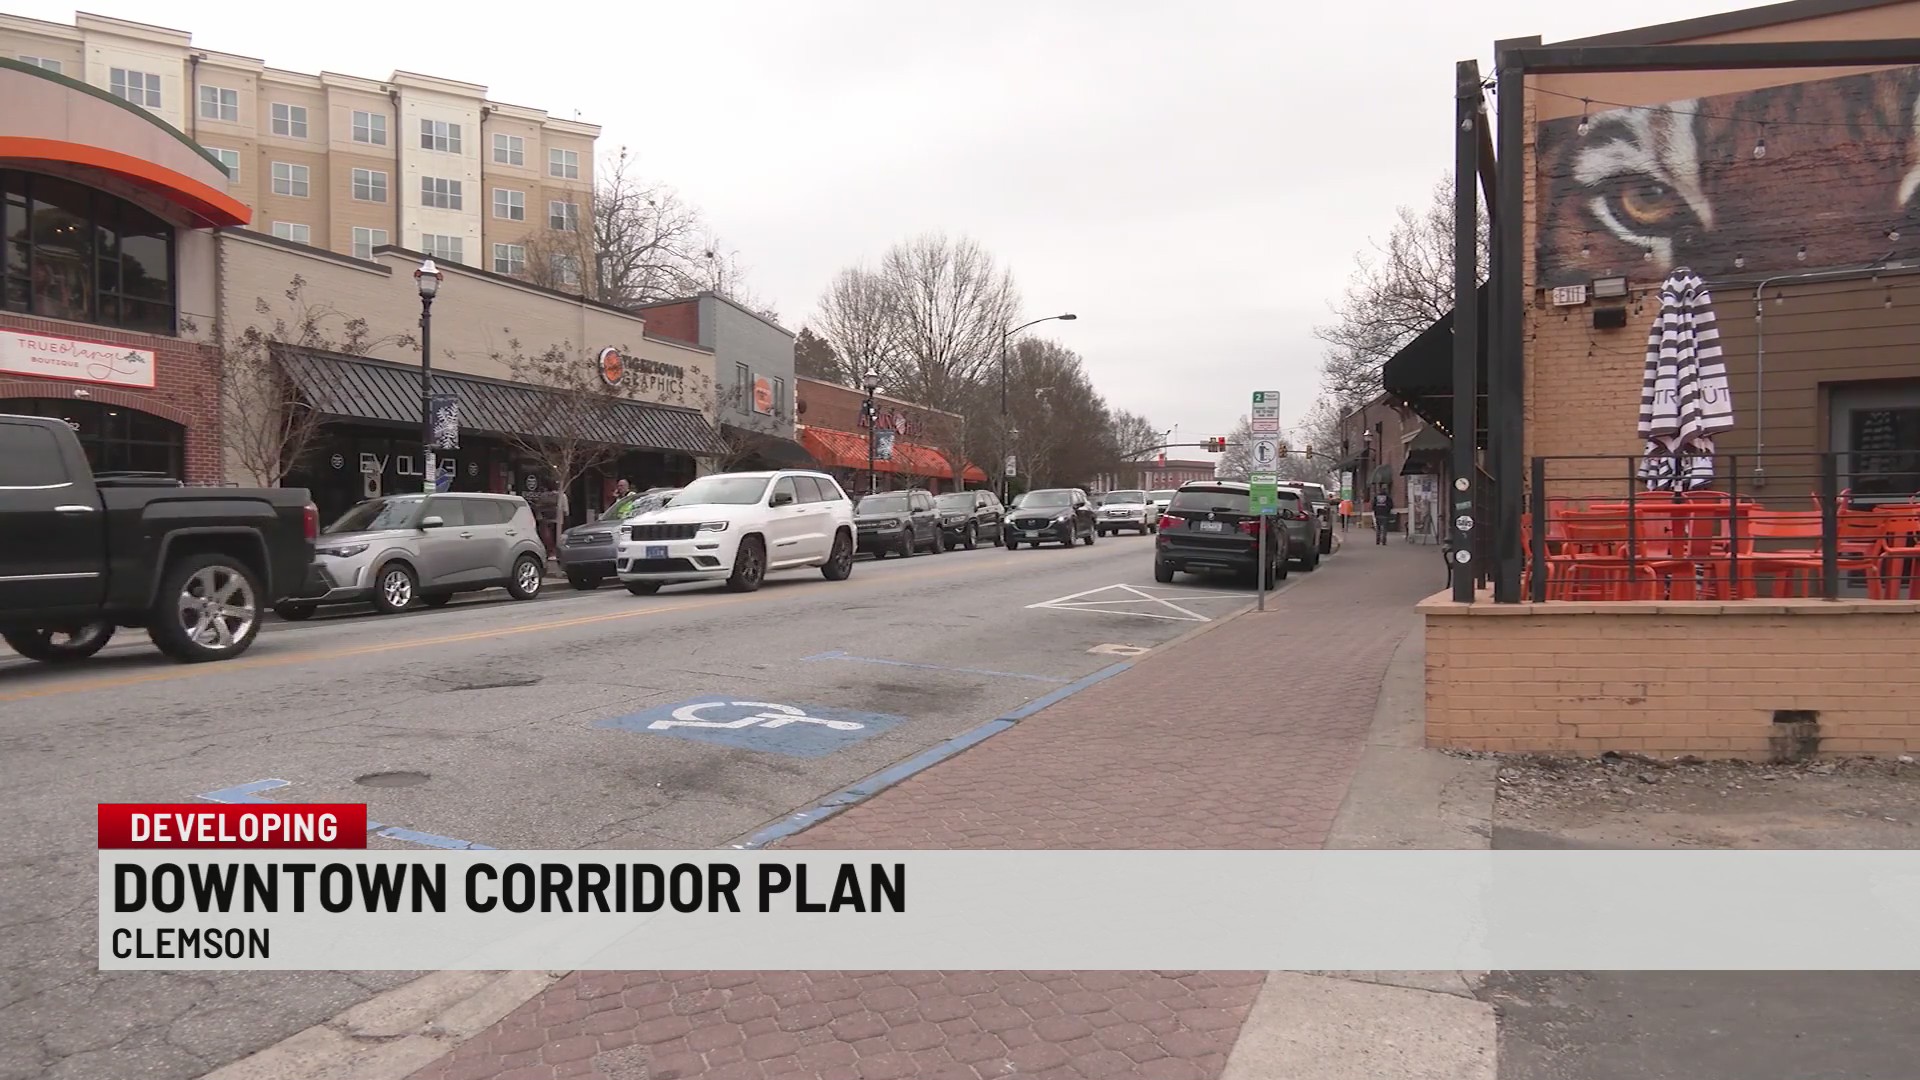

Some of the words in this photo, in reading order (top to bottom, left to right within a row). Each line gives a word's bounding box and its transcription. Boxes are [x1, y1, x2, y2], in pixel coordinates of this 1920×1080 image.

[1558, 286, 1581, 303] EXIT
[18, 338, 60, 353] TRUE
[31, 356, 80, 368] BOUTIQUE
[622, 370, 684, 395] GRAPHICS
[1255, 393, 1262, 401] 2
